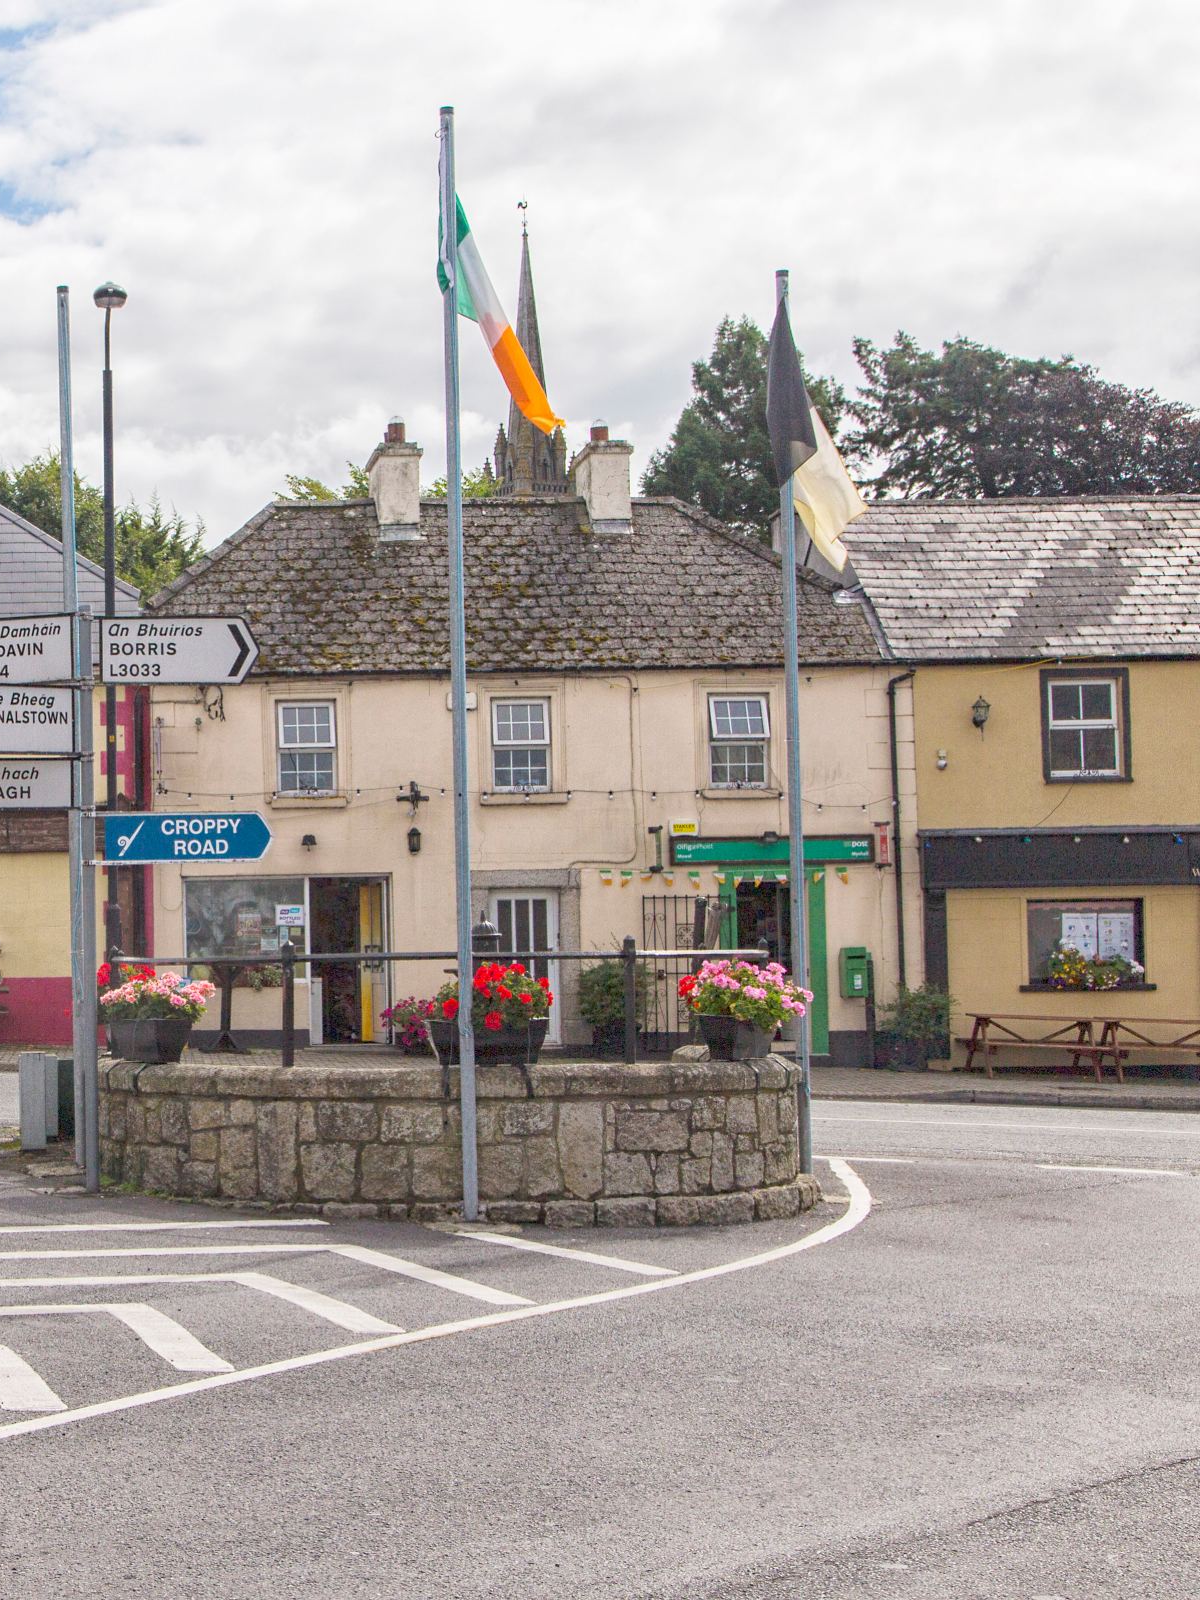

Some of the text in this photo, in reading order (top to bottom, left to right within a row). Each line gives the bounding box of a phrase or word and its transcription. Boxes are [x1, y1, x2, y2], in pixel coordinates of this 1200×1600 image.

[108, 623, 129, 637] An
[110, 642, 177, 656] BORRIS
[110, 663, 161, 677] L3033
[161, 818, 241, 836] CROPPY
[174, 839, 229, 856] ROAD
